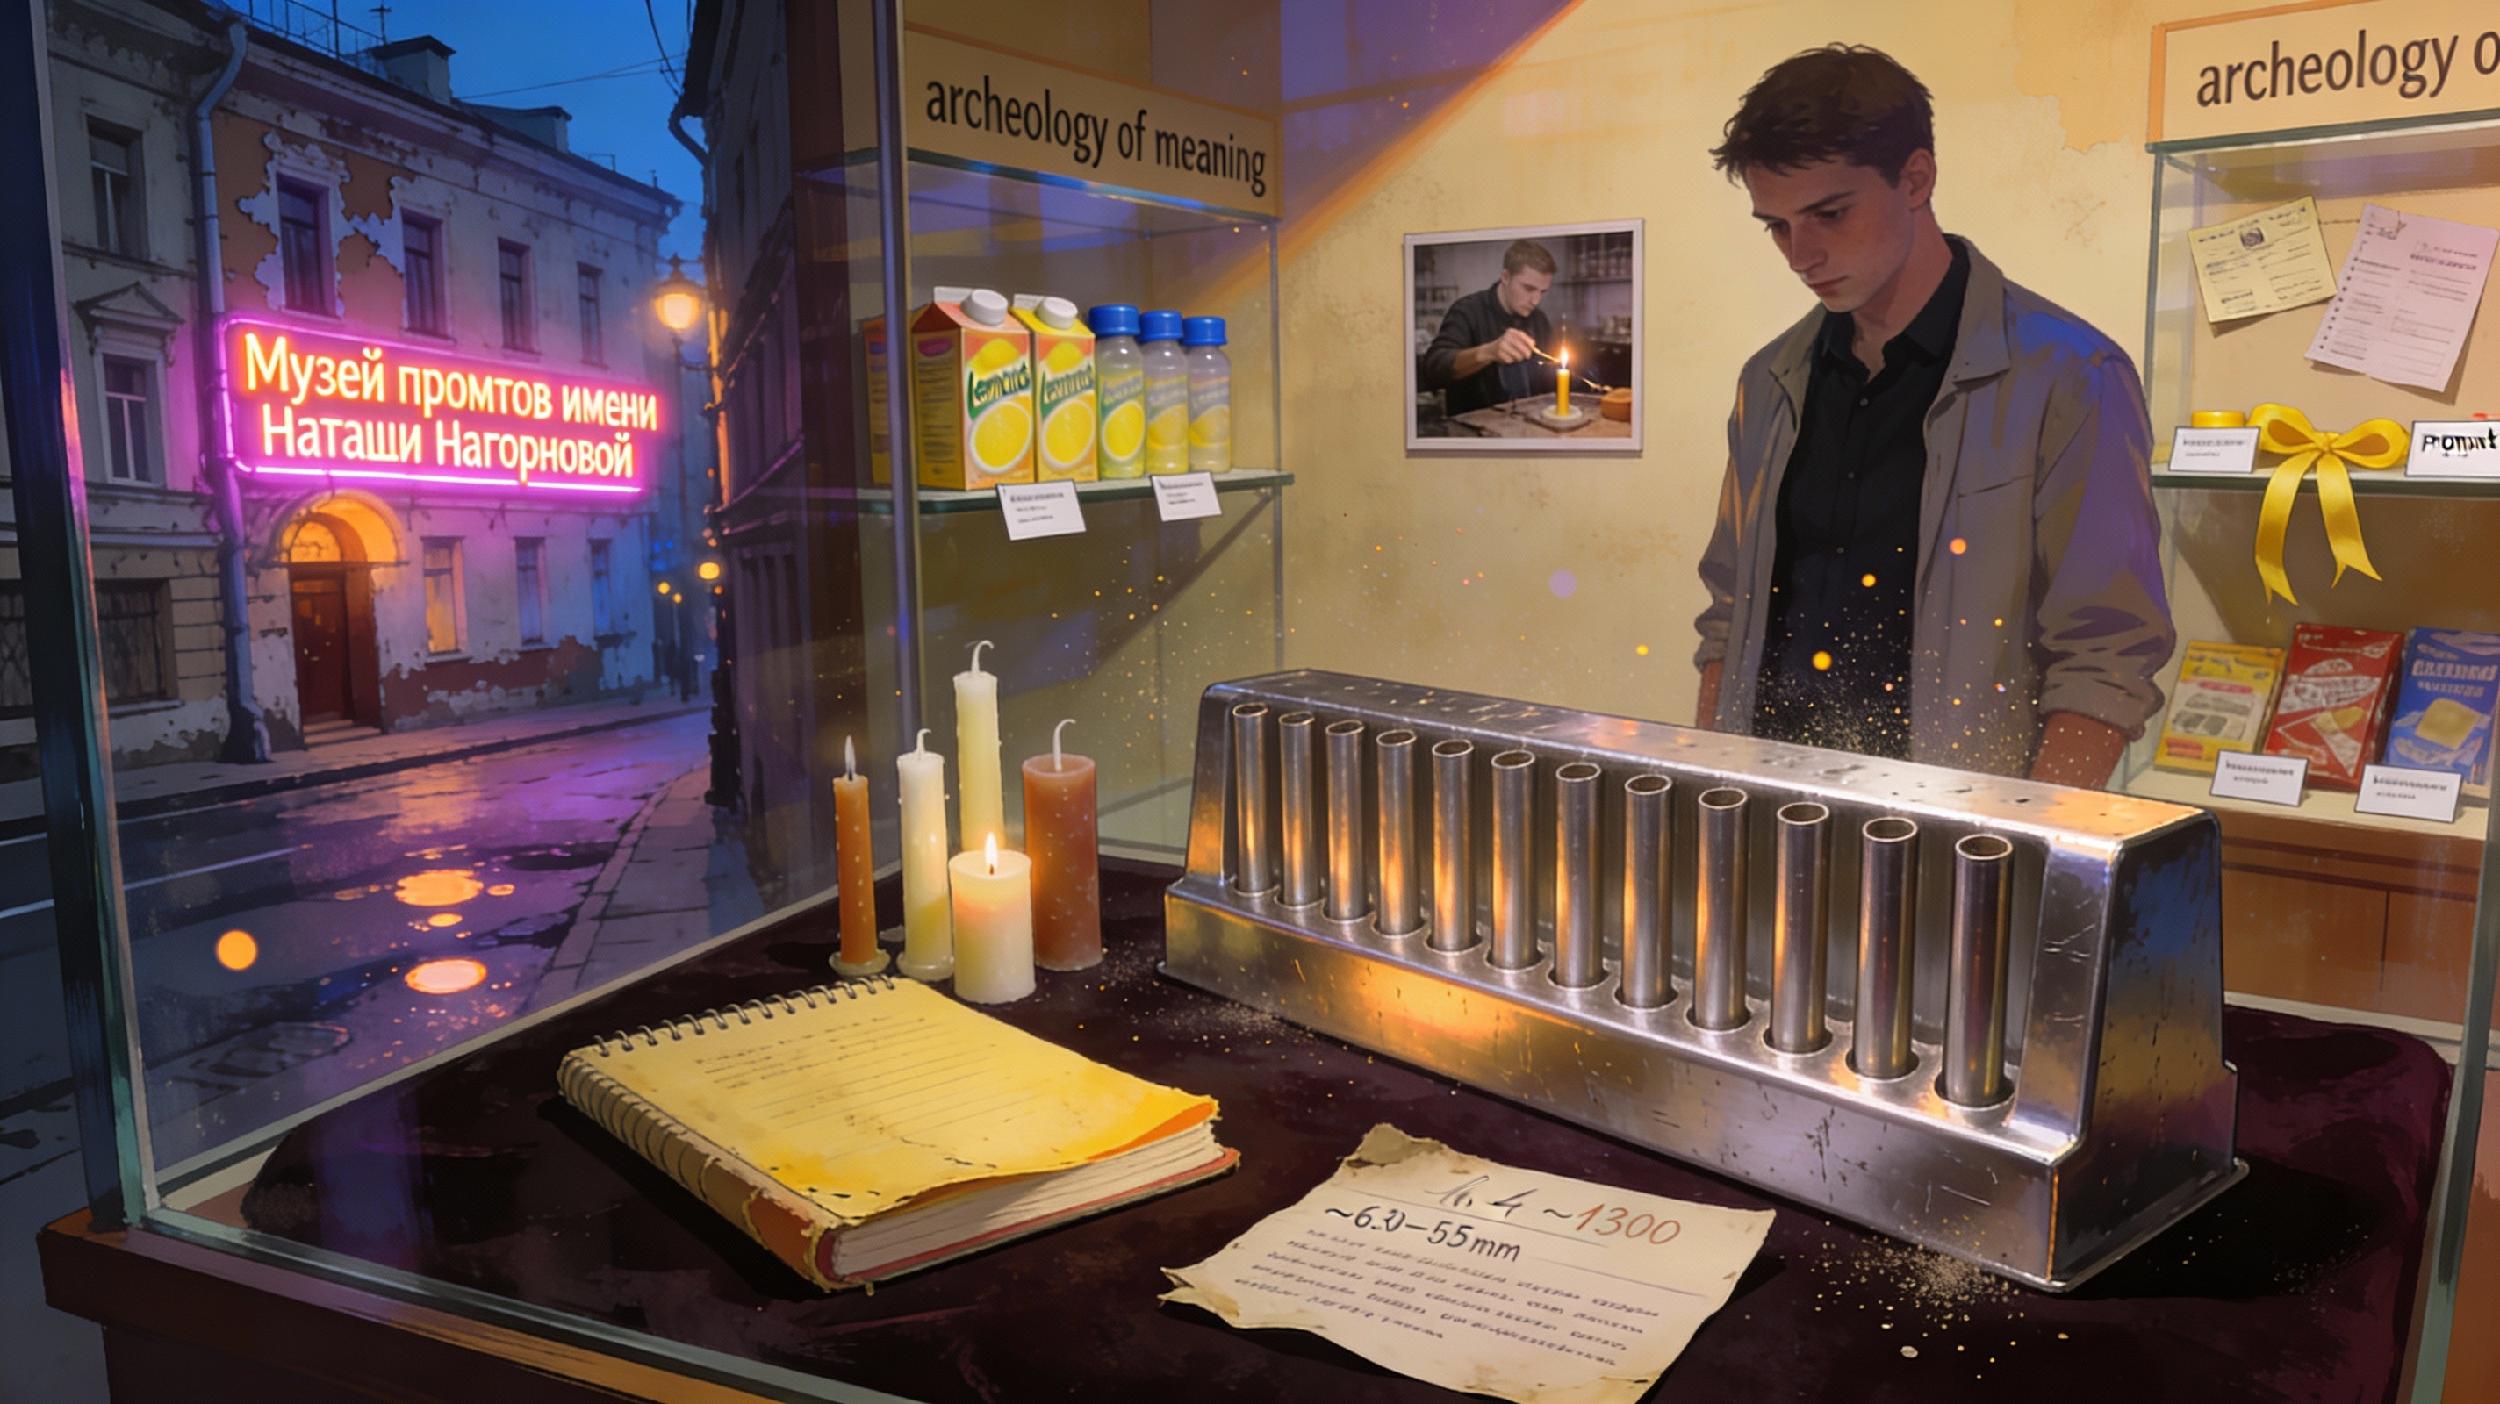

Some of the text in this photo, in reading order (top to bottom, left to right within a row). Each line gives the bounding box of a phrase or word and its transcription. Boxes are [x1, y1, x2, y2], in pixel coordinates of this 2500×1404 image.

[2197, 29, 2459, 107] archeology
[926, 75, 1267, 198] archeology of meaning
[244, 332, 659, 432] Музей промтов имени
[261, 403, 634, 485] Наташи Нагорновой
